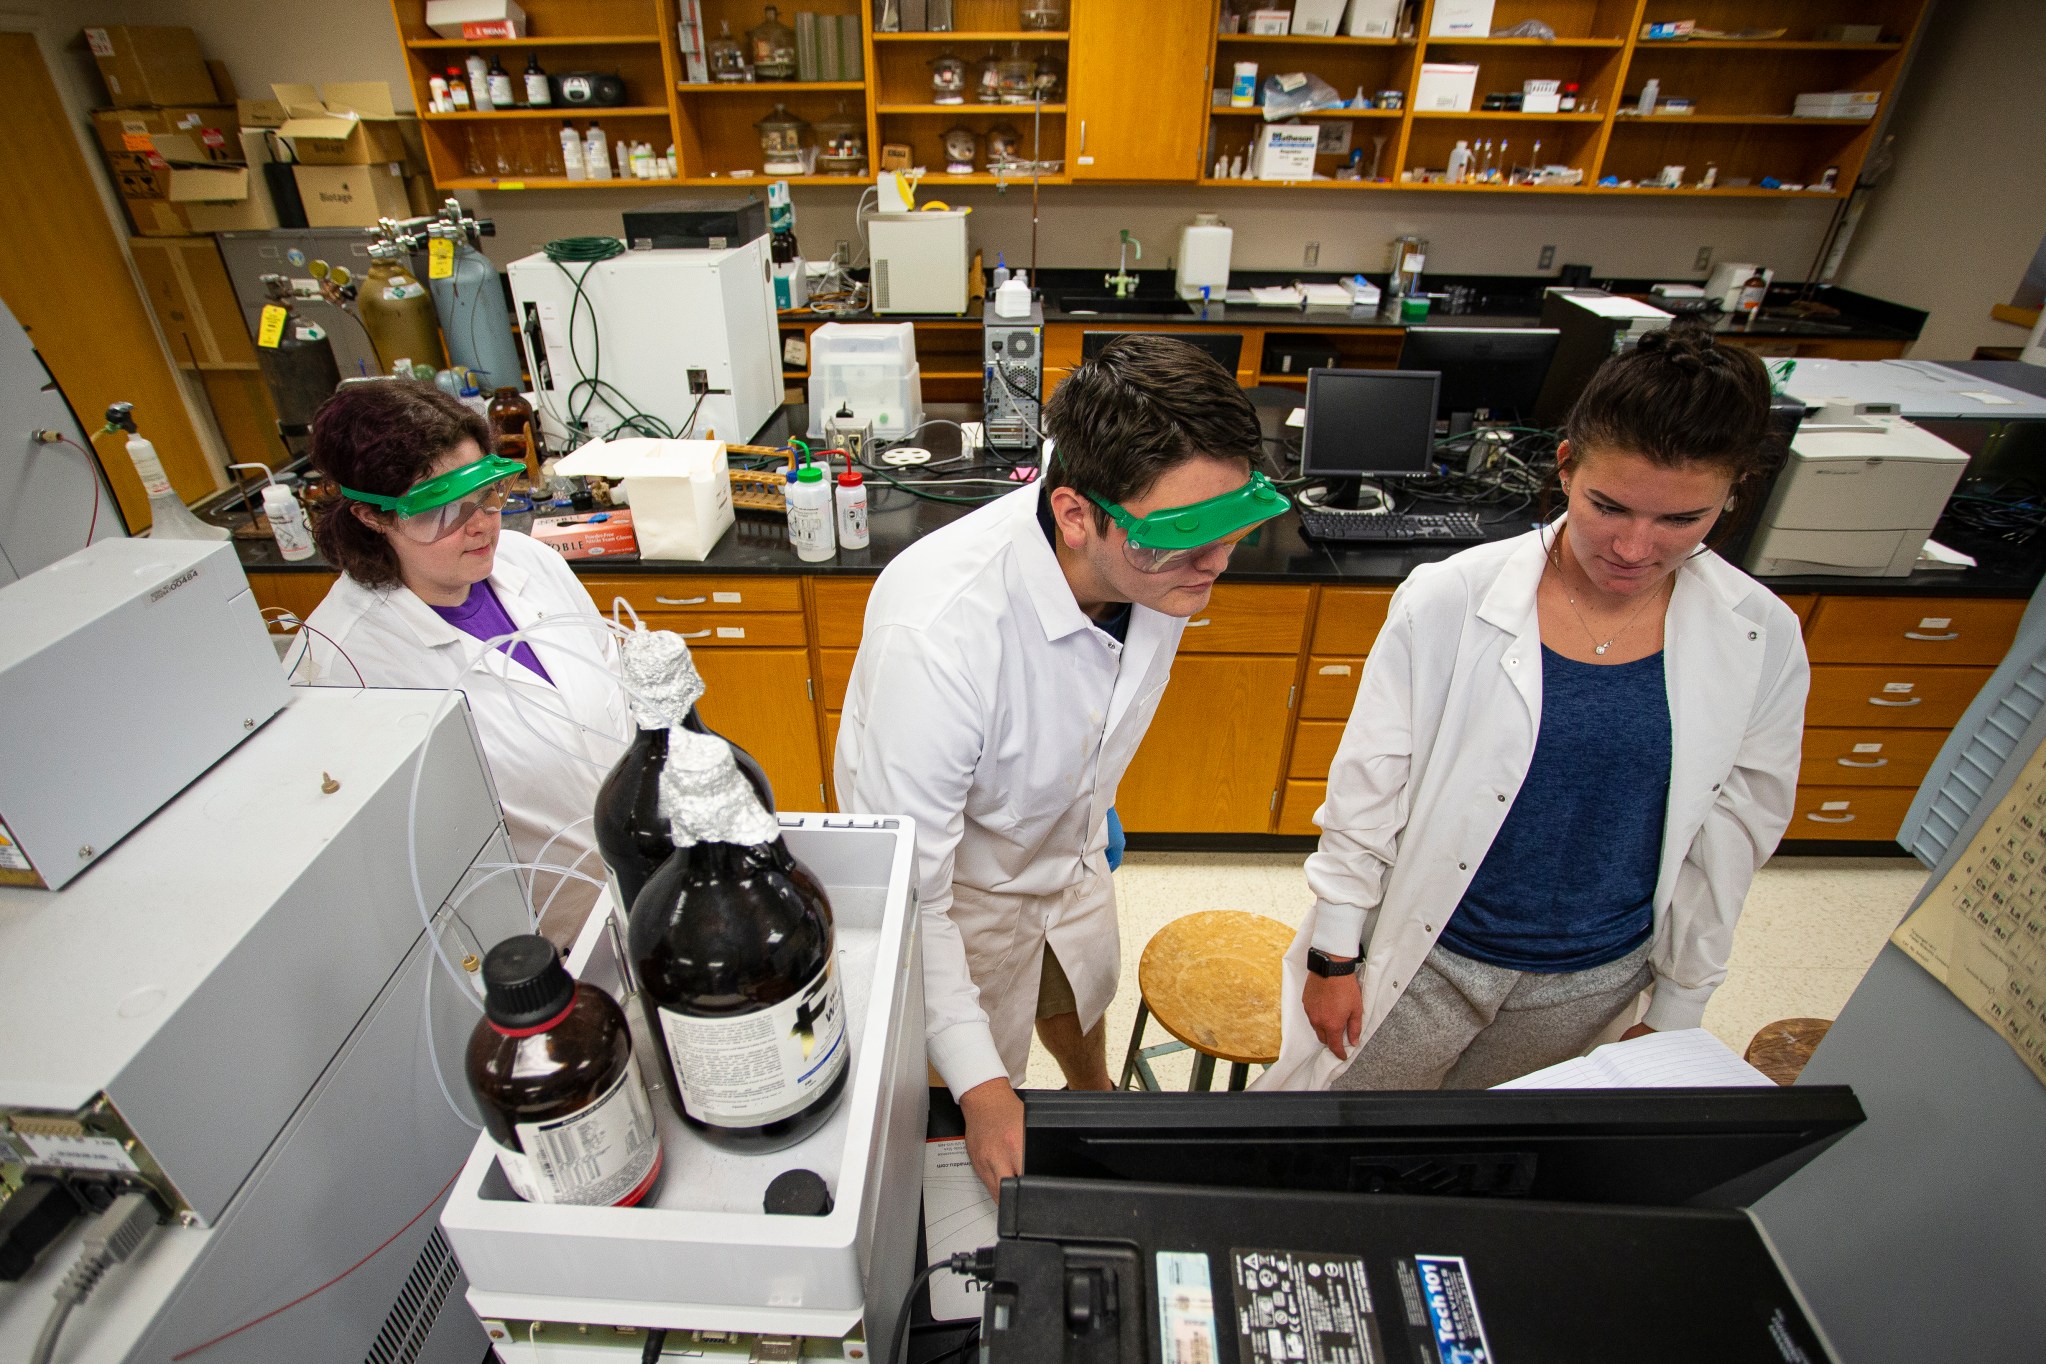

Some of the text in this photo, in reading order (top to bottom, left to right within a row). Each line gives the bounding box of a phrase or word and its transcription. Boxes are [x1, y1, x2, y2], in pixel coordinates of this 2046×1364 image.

[2020, 815, 2033, 829] Na
[2007, 838, 2016, 849] K
[2022, 850, 2035, 865] Ca
[1989, 857, 2002, 871] Rb
[2007, 872, 2019, 884] Sr
[1975, 878, 1986, 891] Cs
[1992, 891, 2004, 906] Ba
[1961, 898, 1971, 909] Fr
[1977, 911, 1989, 925] Ra
[1991, 1002, 2002, 1016] Th
[2025, 1037, 2034, 1049] U
[1422, 1264, 1457, 1343] Tech 101
[1440, 1267, 1466, 1341] SERVICES
